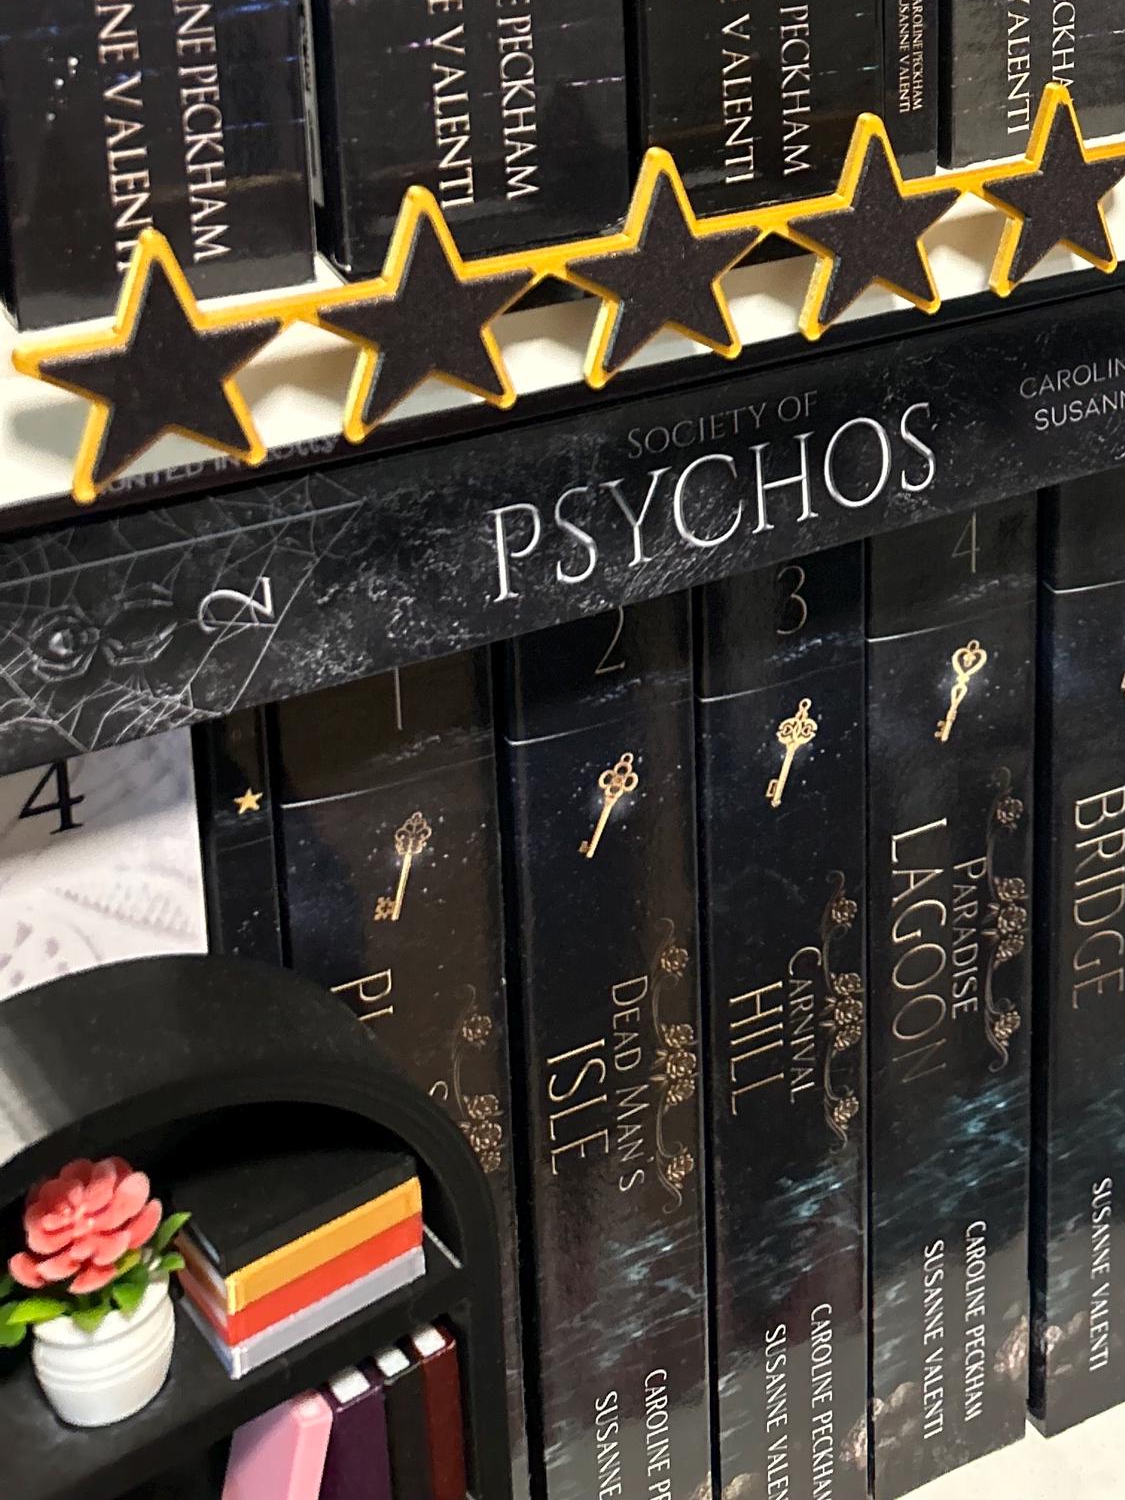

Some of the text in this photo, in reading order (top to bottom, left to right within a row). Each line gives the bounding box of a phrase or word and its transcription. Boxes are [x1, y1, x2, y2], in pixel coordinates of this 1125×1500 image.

[431, 21, 475, 208] VALENTI
[498, 12, 541, 200] PECKHAM
[719, 12, 755, 185] VALENTI
[778, 3, 812, 177] PECKHAM
[899, 55, 911, 113] VALENTI
[911, 51, 924, 111] PECKHAM
[103, 72, 155, 273] VALEN
[179, 63, 231, 263] PECKHAM
[627, 391, 819, 460] SOCIETY OF
[487, 401, 938, 603] PSYCHOS
[950, 511, 980, 574] 4
[198, 576, 277, 633] 2
[594, 605, 626, 675] 2
[775, 566, 807, 636] 3
[18, 758, 85, 835] 4
[889, 816, 948, 1084] LAGOON
[950, 855, 988, 1021] PARADISE
[612, 975, 650, 1194] DEAD MAN'S
[730, 980, 783, 1116] HILL
[788, 944, 822, 1104] CARNIVAL
[547, 1038, 610, 1176] ISLE
[923, 1237, 945, 1440] SUSANNE VALENTI
[963, 1219, 988, 1423] CAROLINE PECKHAM
[1088, 1176, 1113, 1372] SUSANNE VALENTI
[644, 1368, 670, 1478] CAROLINE
[765, 1323, 788, 1433] SUSANNE
[810, 1303, 833, 1409] CAROLINE
[595, 1390, 622, 1500] SUSANNE
